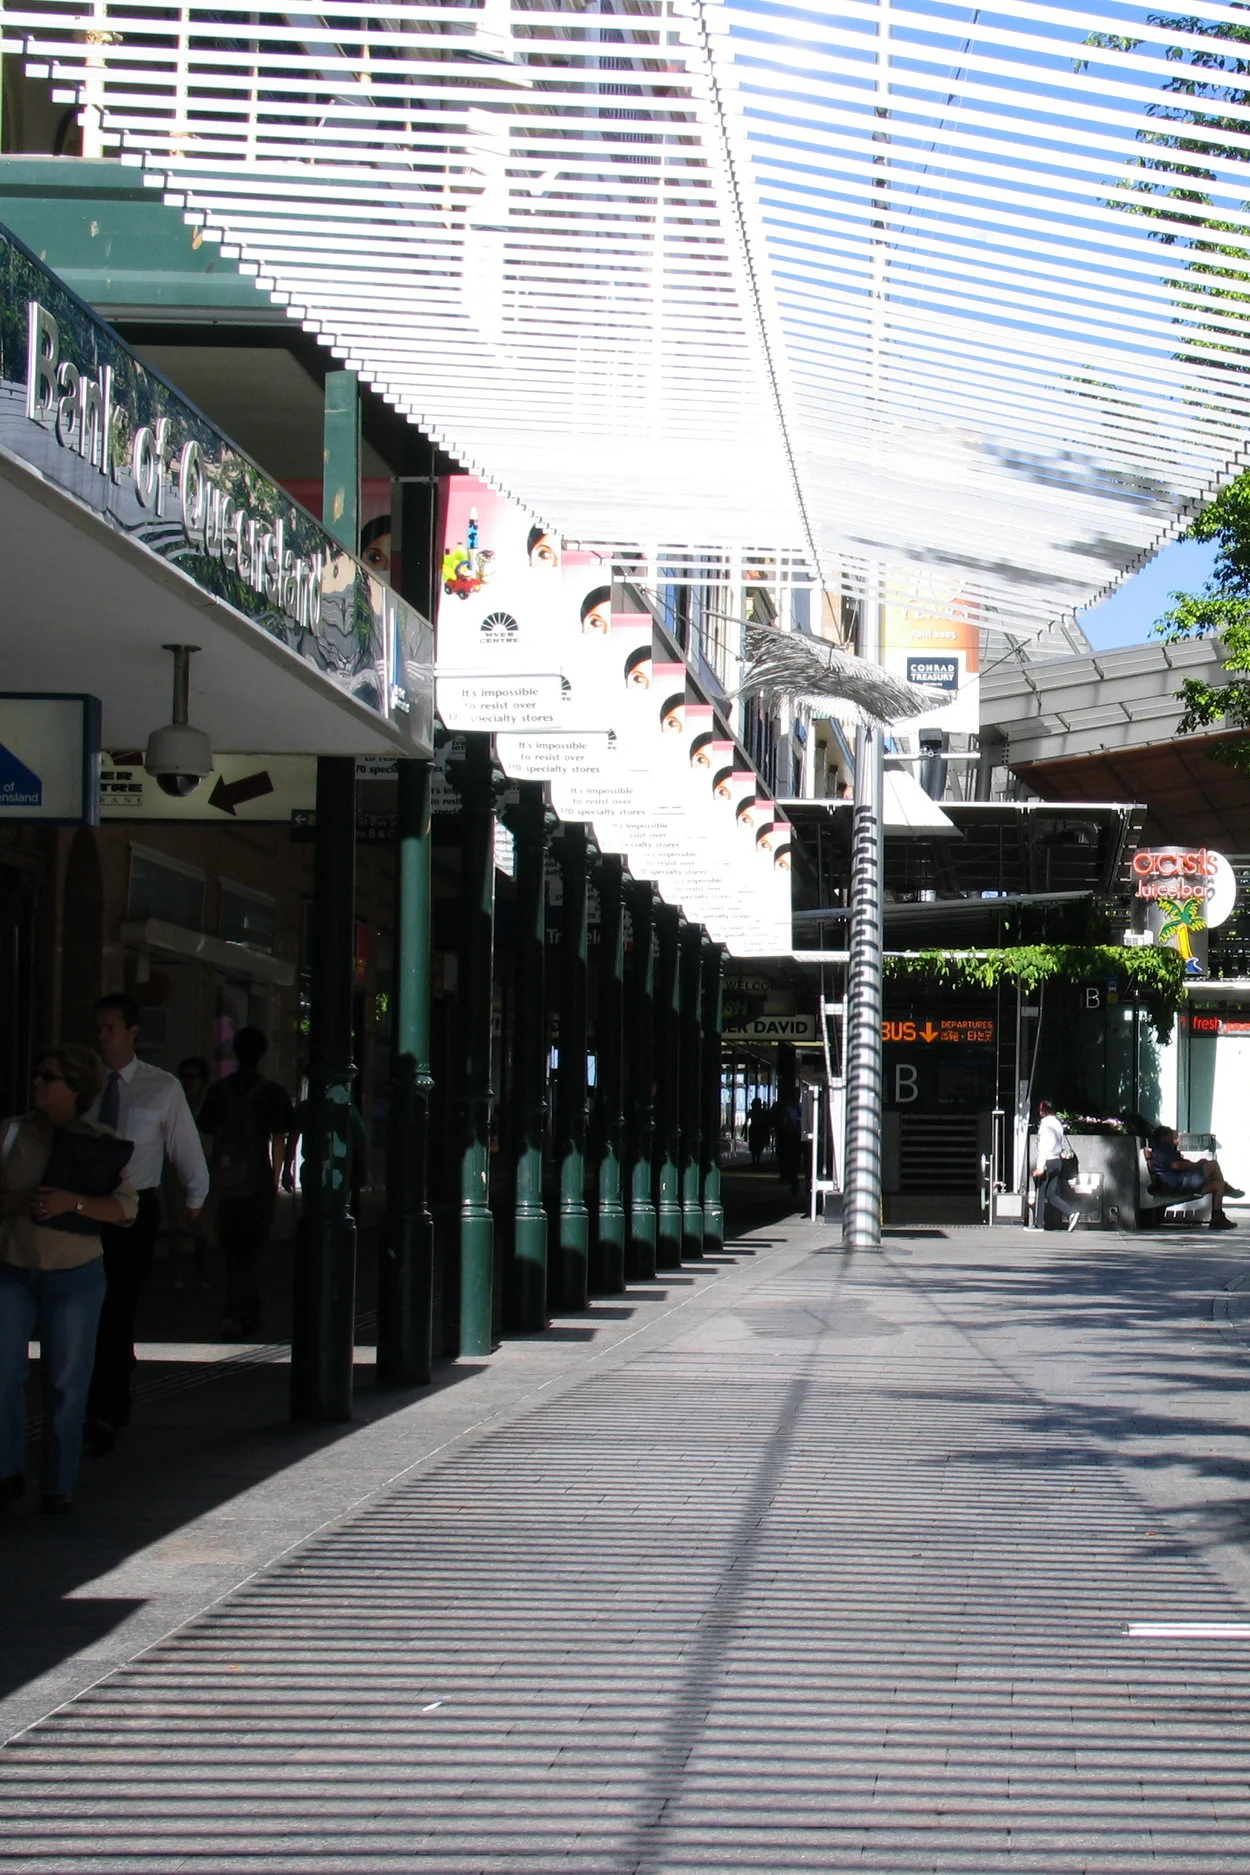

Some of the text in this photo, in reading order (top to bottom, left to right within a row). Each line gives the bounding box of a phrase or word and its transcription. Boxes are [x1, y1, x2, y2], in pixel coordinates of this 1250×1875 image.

[27, 301, 323, 637] Bank of Queensland
[934, 631, 957, 640] 2005
[911, 664, 954, 672] CONRAD
[911, 673, 954, 681] TREASURY
[462, 688, 538, 699] It's impossible
[480, 701, 508, 709] resist
[521, 714, 554, 722] stores
[518, 741, 587, 751] It's impossible
[521, 753, 531, 761] to
[535, 753, 560, 761] resist
[526, 764, 567, 775] specialty
[101, 771, 133, 780] ER
[3, 782, 15, 792] of
[101, 783, 143, 792] TRE
[587, 787, 633, 796] impossible
[0, 792, 39, 802] nsland
[577, 808, 615, 817] specialty
[1133, 848, 1218, 876] oasis
[1180, 877, 1207, 897] bar
[1085, 987, 1100, 1009] B
[754, 1021, 808, 1034] DAVID
[941, 1020, 993, 1029] DEPARTURES
[1193, 1016, 1222, 1030] fresh
[881, 1021, 917, 1042] BUS
[895, 1063, 919, 1103] B
